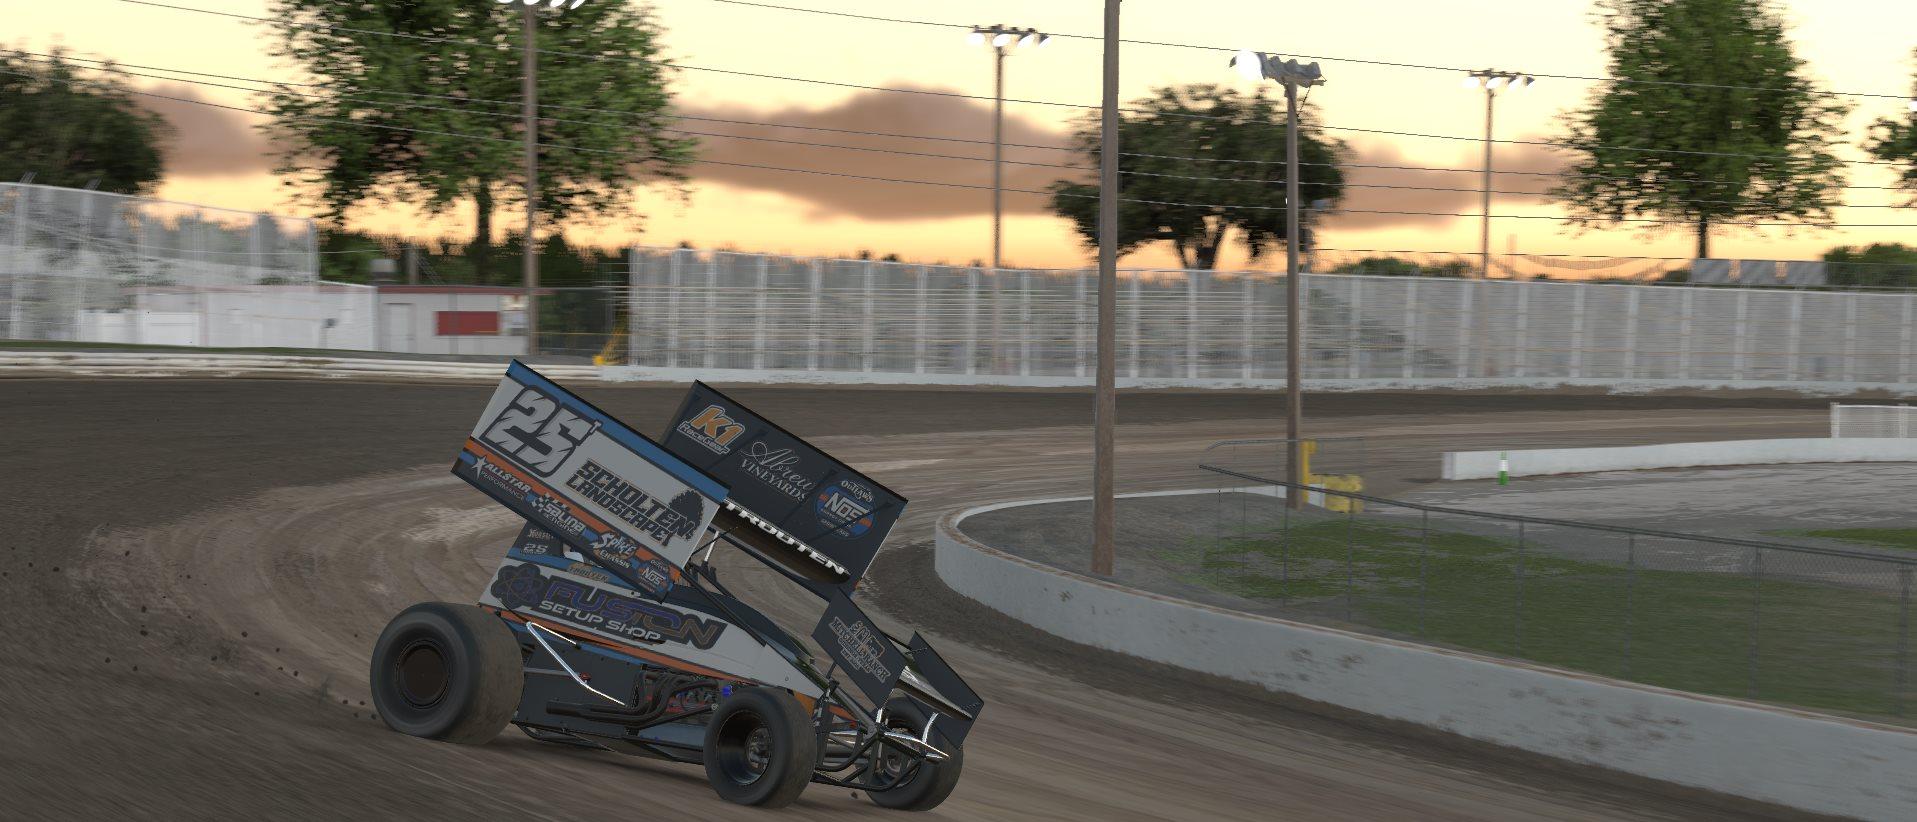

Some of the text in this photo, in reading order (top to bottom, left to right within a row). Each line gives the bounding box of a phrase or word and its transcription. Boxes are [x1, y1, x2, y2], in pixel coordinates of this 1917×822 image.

[689, 405, 745, 447] K1
[484, 463, 532, 493] ALLSTAR
[739, 441, 816, 490] Abreu
[740, 458, 808, 504] VINEYARDS
[566, 474, 670, 543] LANDSCAPE
[577, 459, 698, 538] SCHOLTEN
[823, 491, 870, 523] NOS
[539, 600, 661, 641] SETUP SHOP
[546, 577, 725, 648] FUSION
